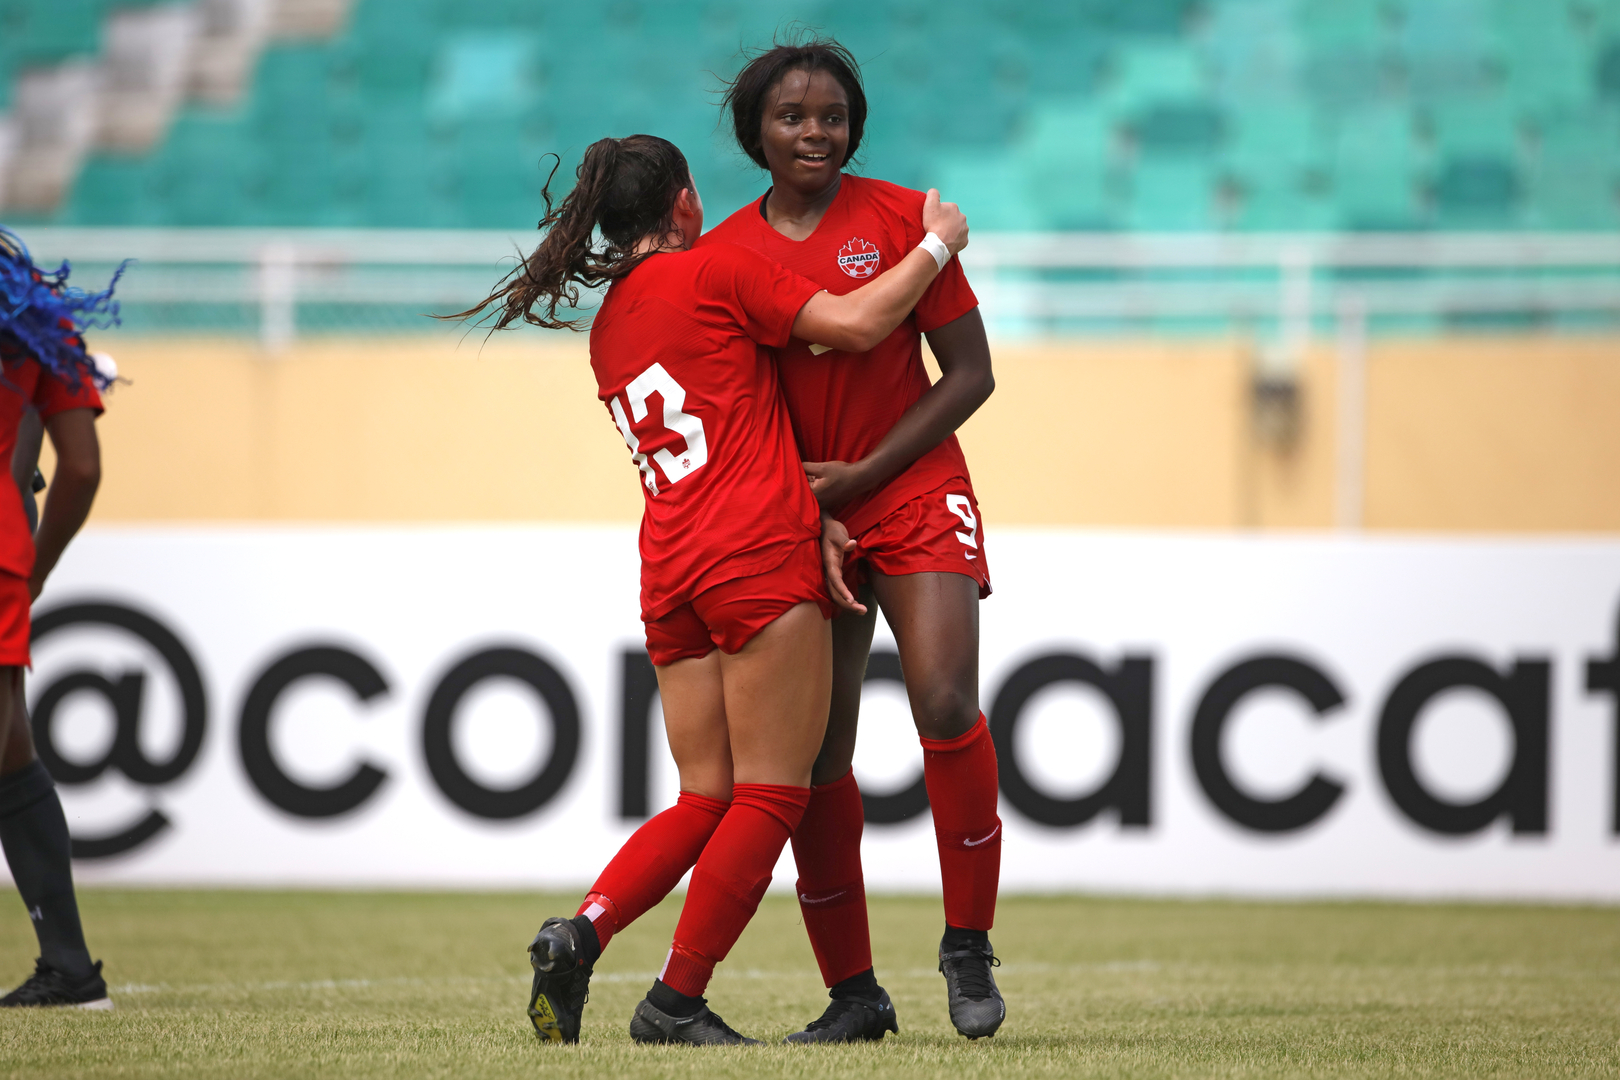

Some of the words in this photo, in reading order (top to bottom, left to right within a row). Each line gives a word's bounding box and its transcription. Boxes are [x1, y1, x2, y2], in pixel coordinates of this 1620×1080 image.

[839, 253, 879, 264] CANADA
[610, 362, 708, 497] 13
[946, 493, 978, 549] 9
